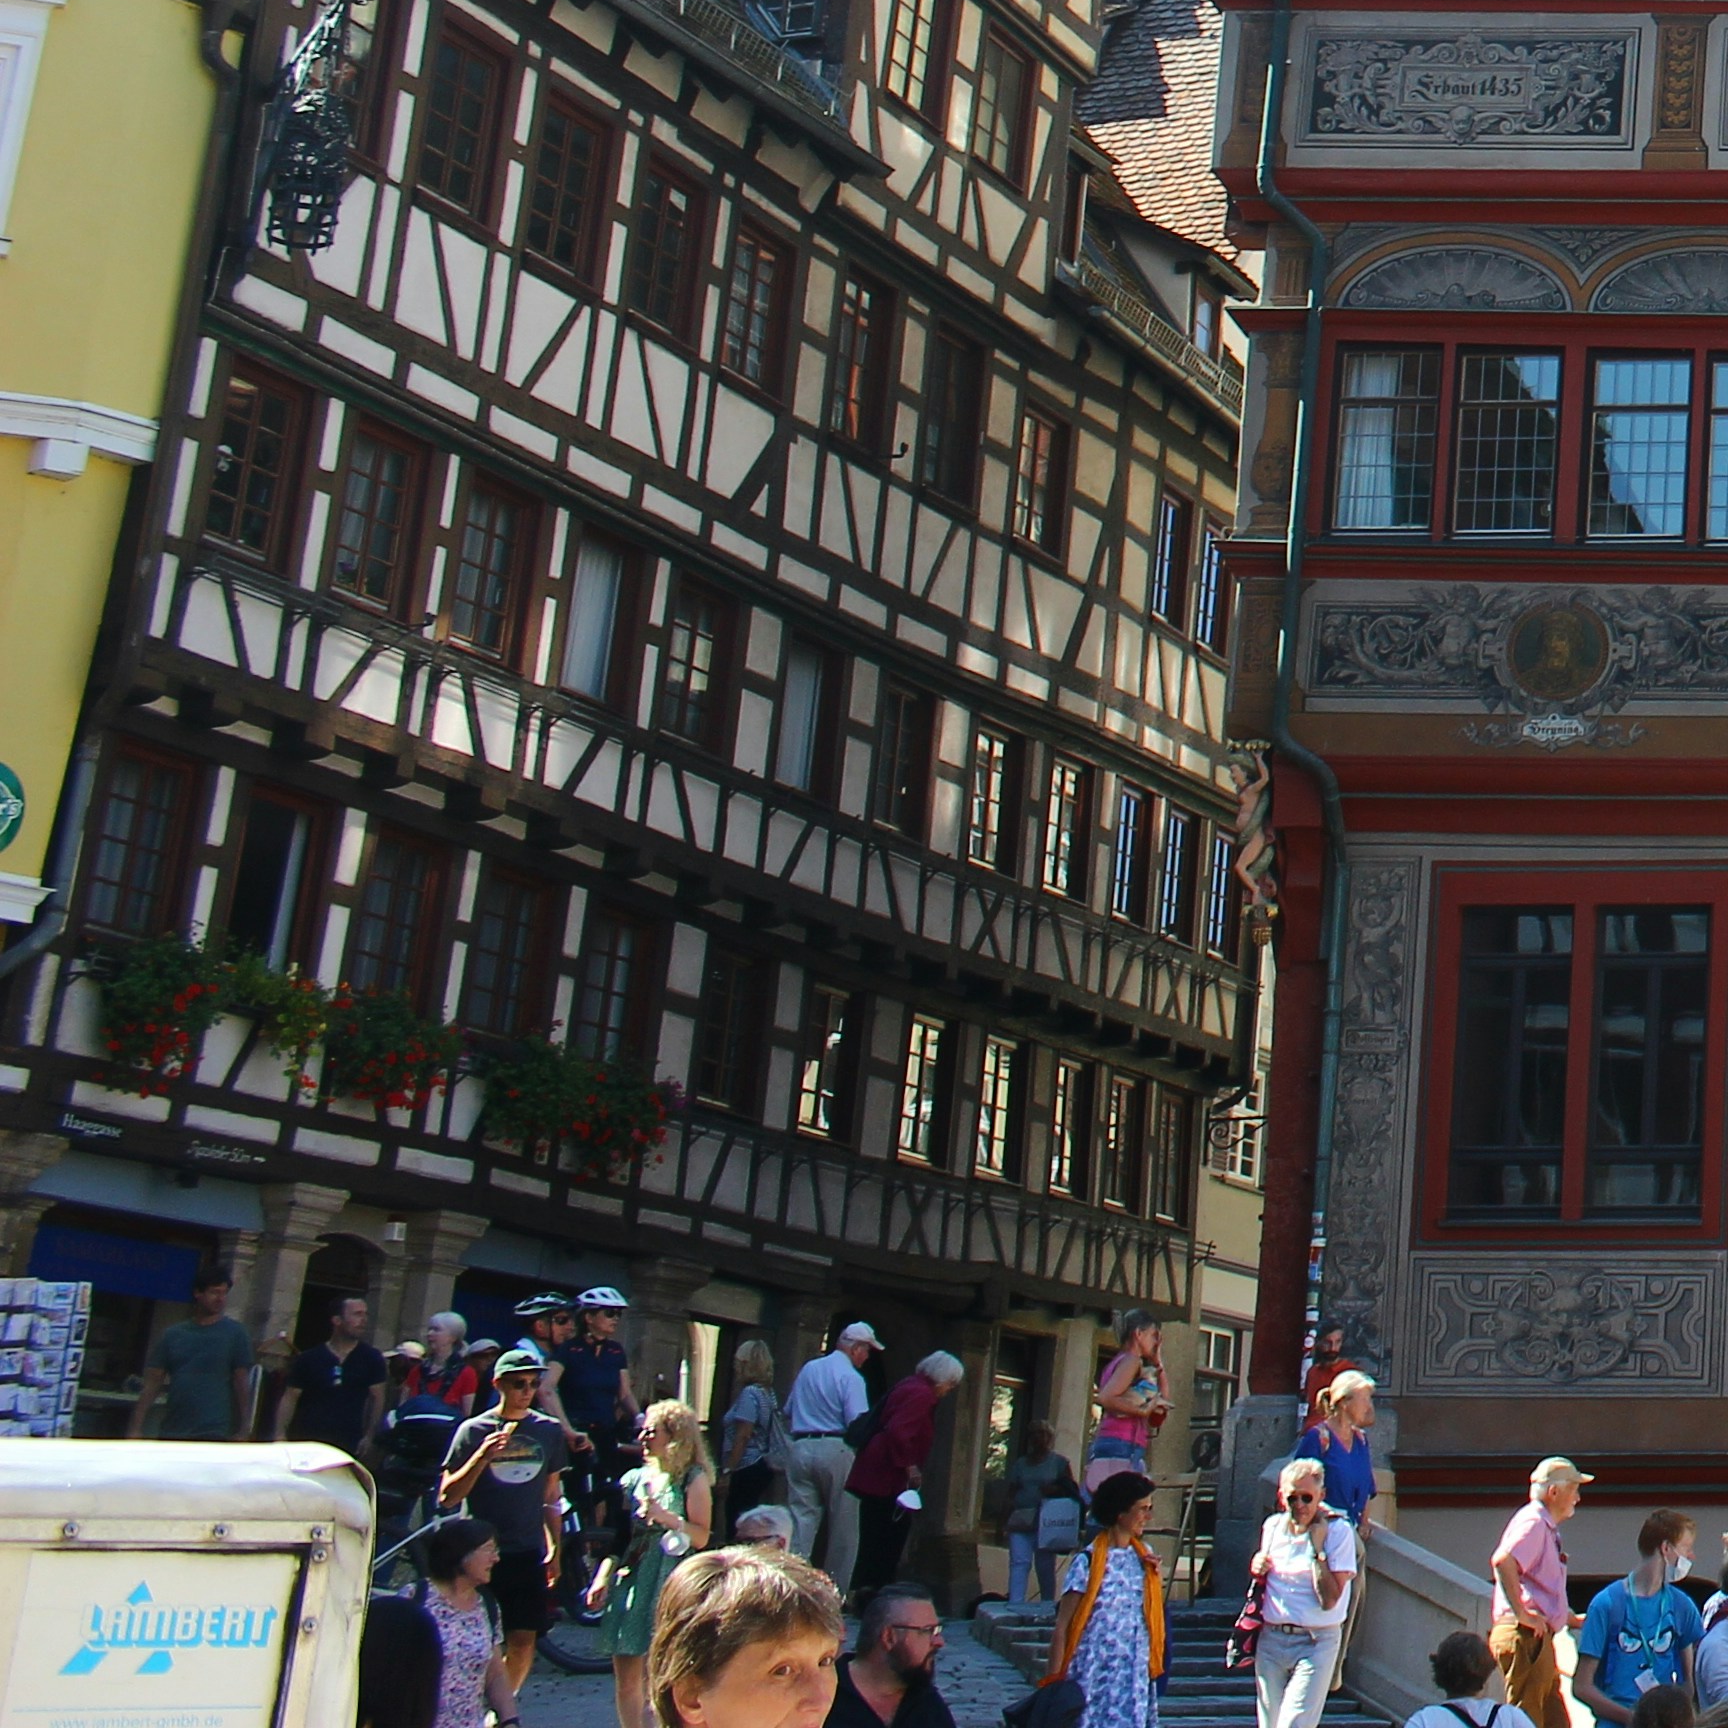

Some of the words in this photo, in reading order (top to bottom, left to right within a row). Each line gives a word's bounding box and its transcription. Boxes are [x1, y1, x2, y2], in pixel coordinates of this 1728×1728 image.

[1411, 74, 1475, 102] Erbaut
[1479, 75, 1524, 97] 1435
[61, 1112, 123, 1138] Haaggasse
[80, 1603, 278, 1648] LAMBERT
